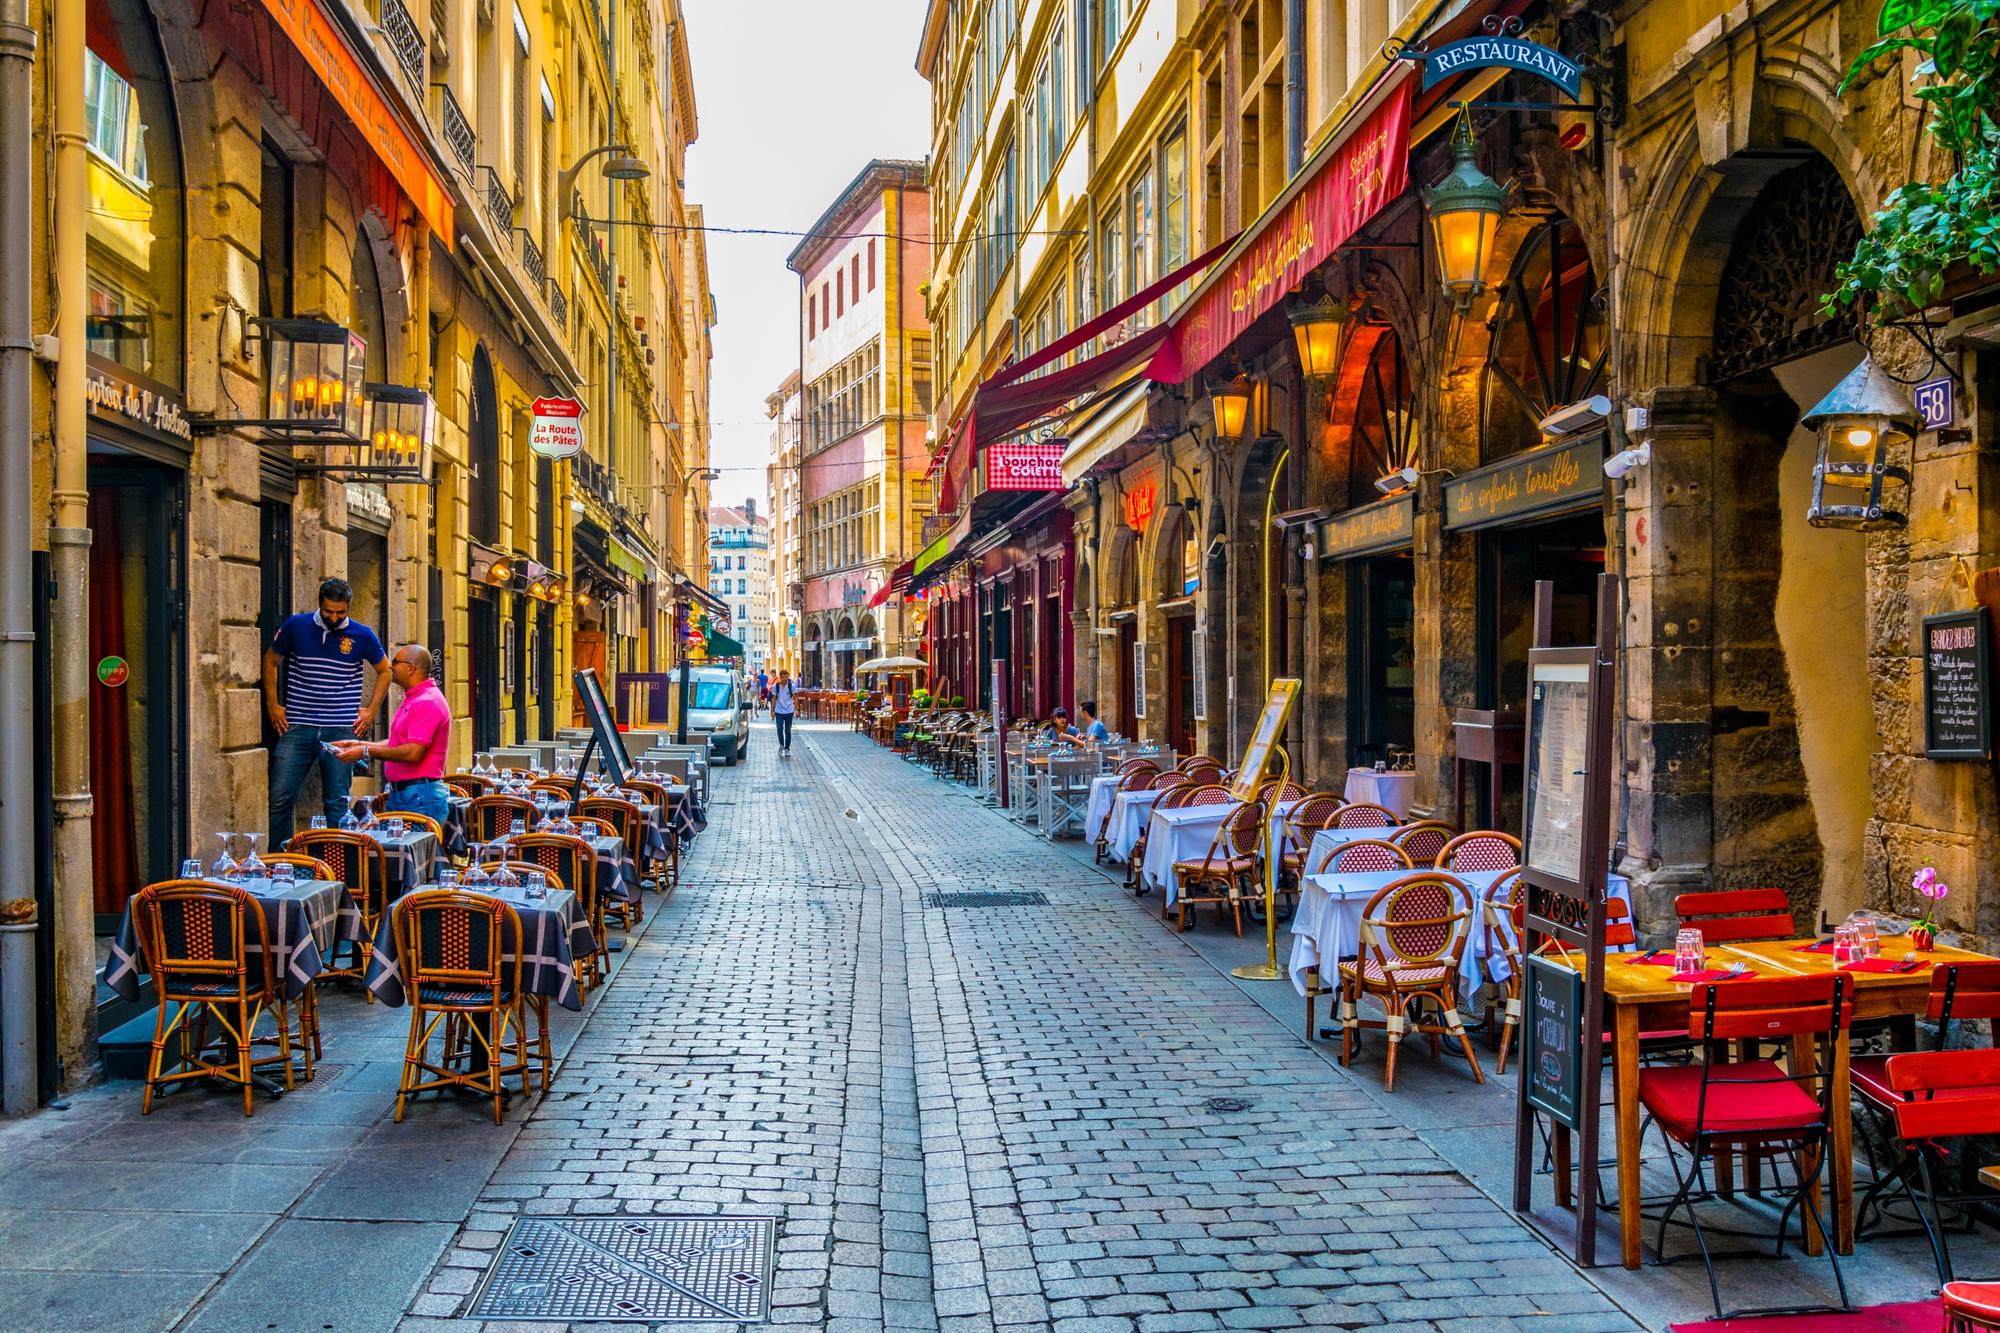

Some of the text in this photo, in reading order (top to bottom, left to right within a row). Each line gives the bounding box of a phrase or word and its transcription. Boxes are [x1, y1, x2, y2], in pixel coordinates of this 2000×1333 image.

[1435, 43, 1575, 83] RESTAURANT
[1247, 243, 1273, 321] enfants
[1275, 191, 1314, 279] terribles
[540, 402, 573, 410] Fabrication
[1920, 388, 1945, 423] 58
[533, 434, 578, 446] des Pâtes
[536, 423, 577, 435] La Route
[1002, 455, 1061, 467] bouchon
[1479, 472, 1518, 514] enfants
[1526, 449, 1580, 495] terribles
[1371, 501, 1404, 539] terribles
